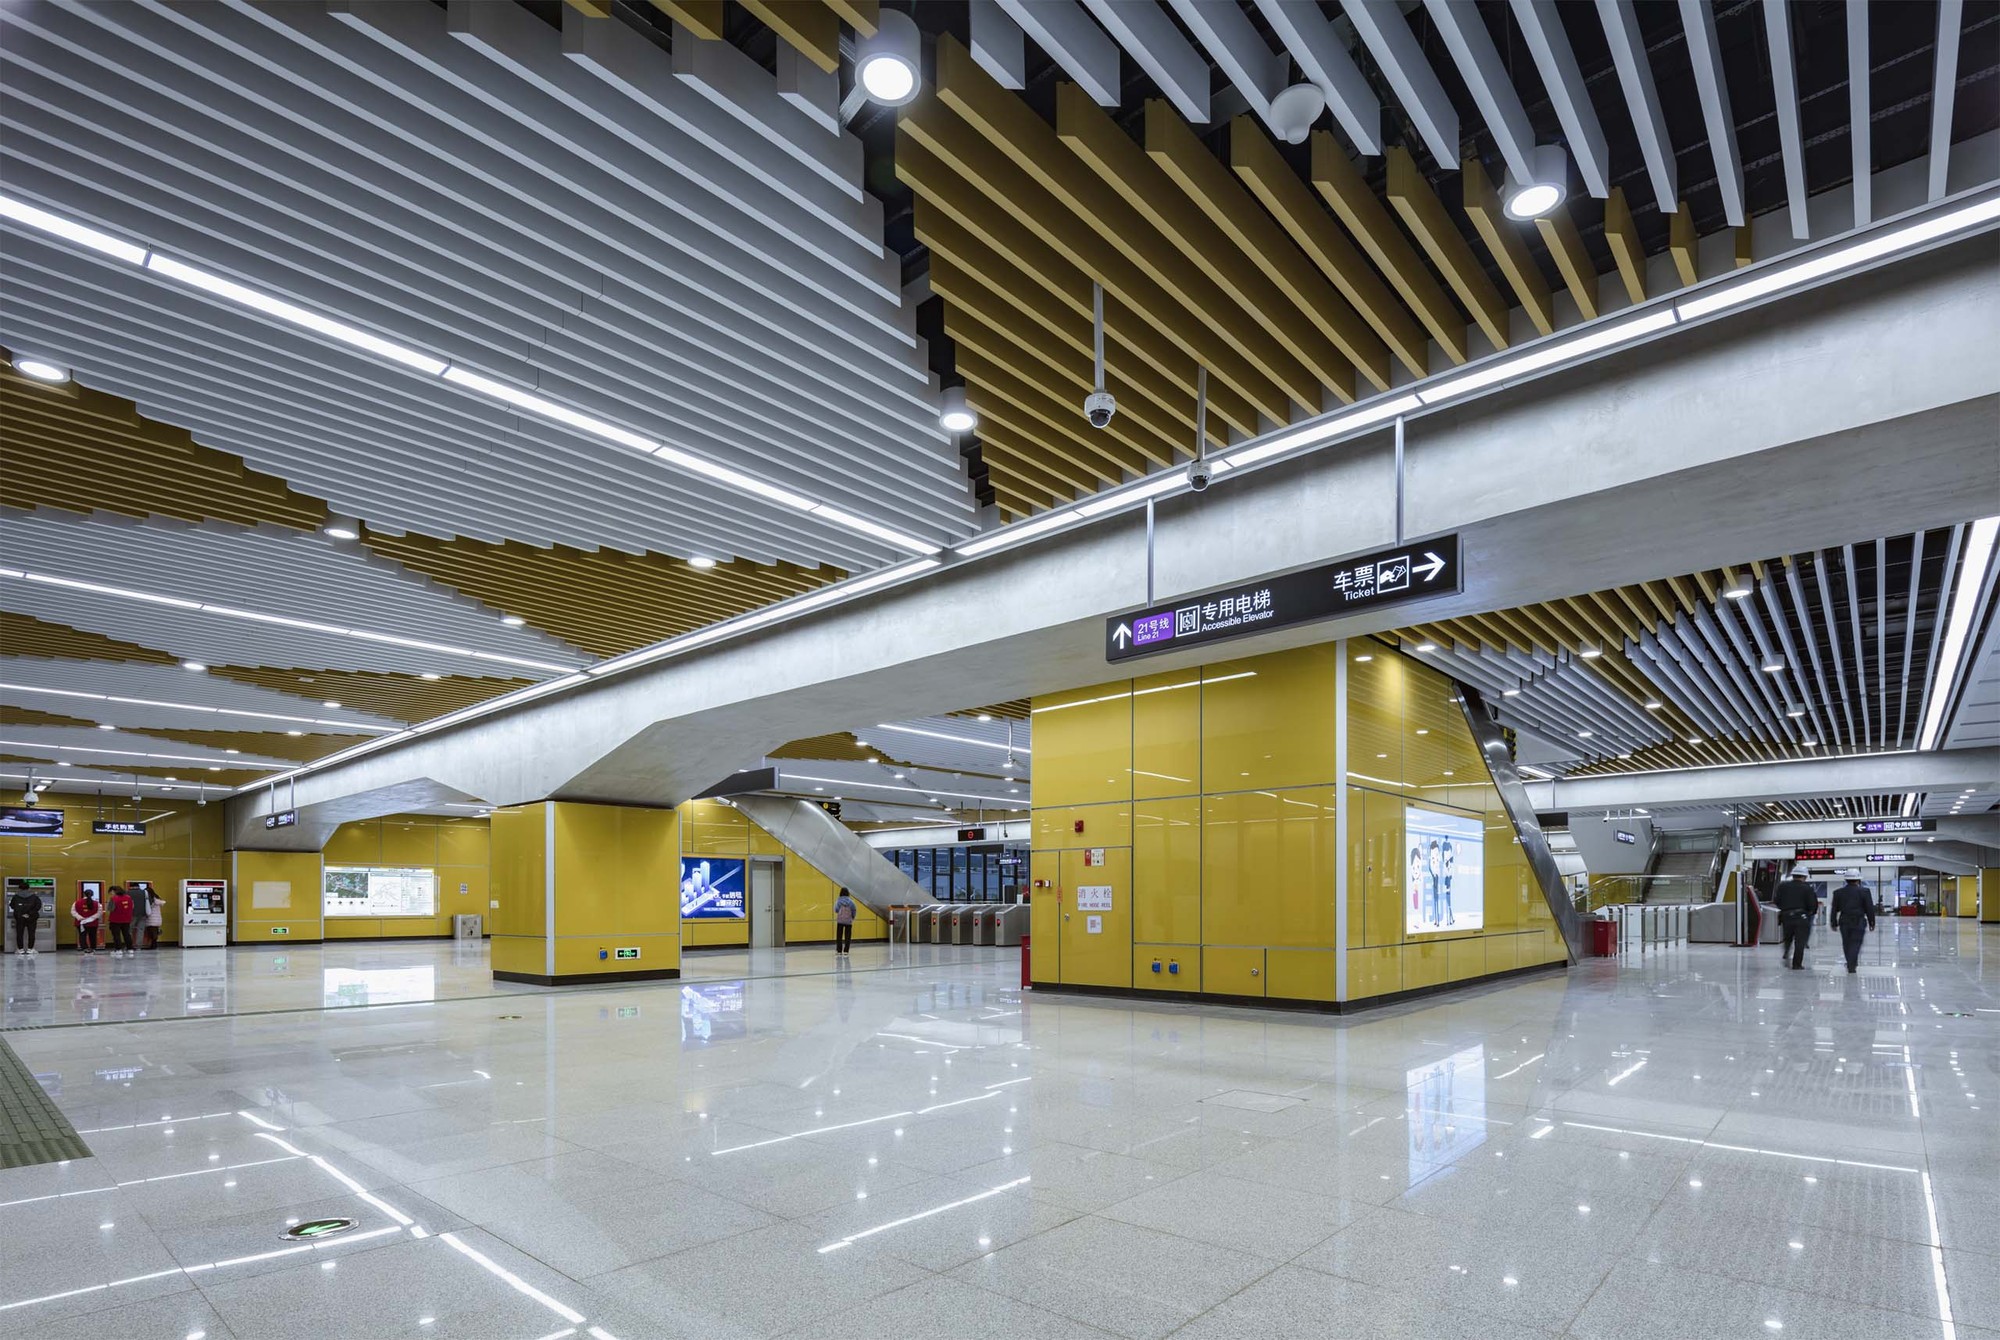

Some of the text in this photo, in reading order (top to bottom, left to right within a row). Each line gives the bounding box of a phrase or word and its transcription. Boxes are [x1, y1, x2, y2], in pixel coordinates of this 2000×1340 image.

[1333, 564, 1375, 592] 车票
[1343, 586, 1375, 600] Ticket
[1201, 589, 1271, 621] 专用电梯
[1137, 617, 1170, 635] 21号线
[1201, 609, 1275, 633] Accessible Elevator
[1137, 631, 1159, 642] Line 21
[1078, 888, 1111, 898] 消火栓
